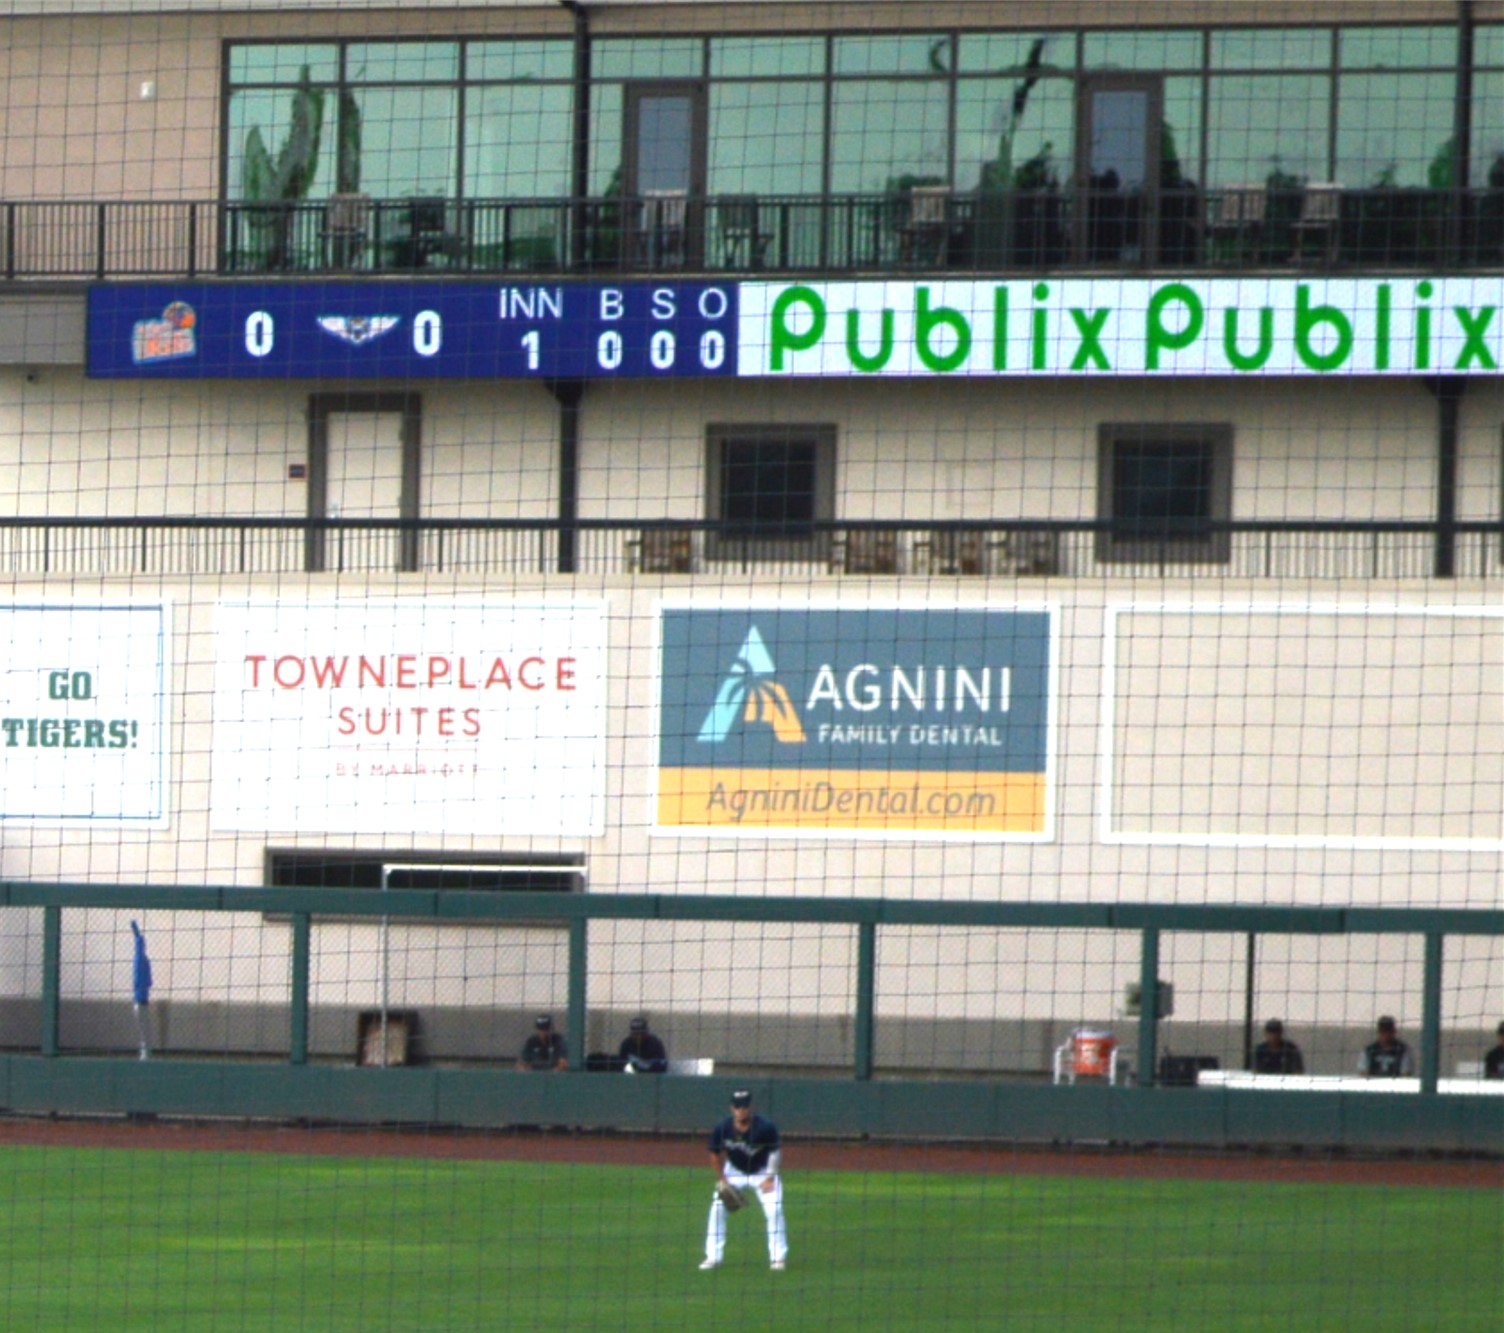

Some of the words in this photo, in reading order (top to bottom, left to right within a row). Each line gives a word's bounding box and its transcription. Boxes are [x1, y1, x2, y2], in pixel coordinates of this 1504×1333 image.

[499, 287, 564, 319] INN
[599, 288, 624, 320] B
[651, 288, 676, 320] S
[698, 287, 728, 320] O
[244, 310, 274, 357] 0
[412, 309, 442, 356] 0
[769, 282, 1112, 373] Publix
[1145, 280, 1499, 372] Publix
[521, 330, 539, 370] 1
[597, 330, 623, 370] 0
[650, 330, 676, 370] 0
[700, 330, 726, 370] 0
[48, 671, 91, 700] GO
[245, 655, 577, 691] TOWNEPLACE
[806, 664, 1010, 712] AGNINI
[1, 718, 139, 748] TIGERS!
[338, 706, 480, 736] SUITES
[819, 724, 900, 744] FAMILY
[910, 724, 1002, 746] DENTAL
[706, 780, 995, 822] AgniniDental.com
